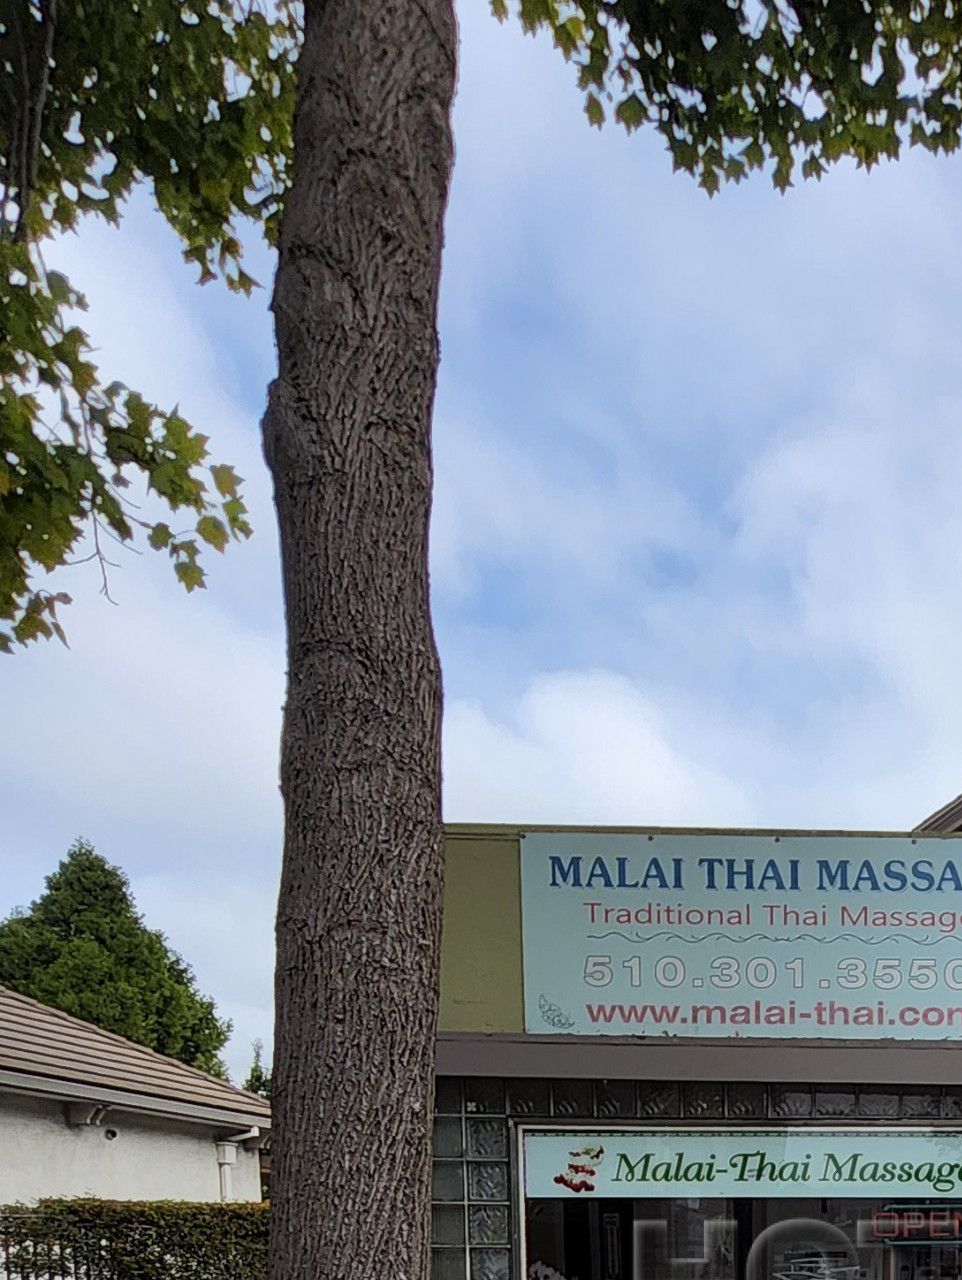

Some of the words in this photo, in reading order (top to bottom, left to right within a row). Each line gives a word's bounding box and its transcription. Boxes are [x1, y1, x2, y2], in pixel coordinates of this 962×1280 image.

[548, 856, 684, 891] MALAI
[698, 858, 799, 892] THAI
[583, 902, 751, 926] Traditional
[762, 904, 828, 926] Thai
[611, 1150, 810, 1183] Malai-Thai
